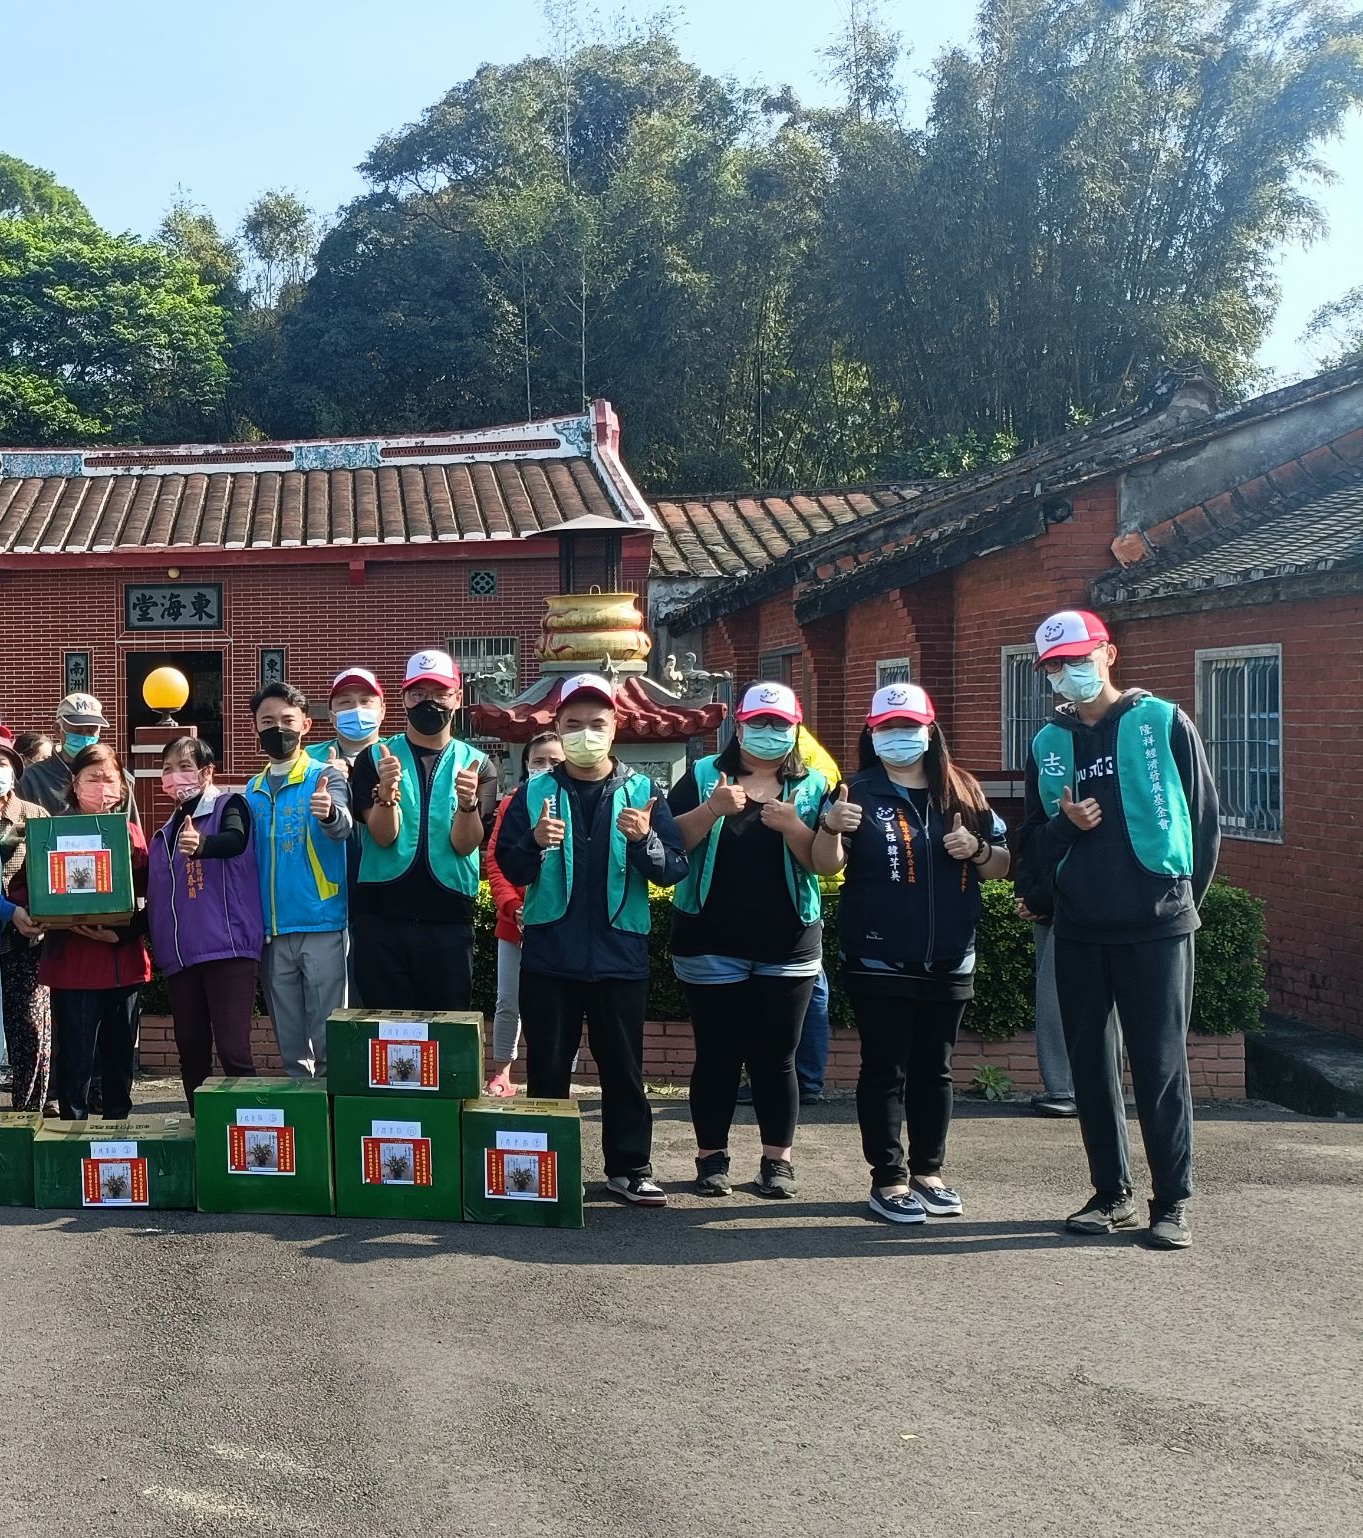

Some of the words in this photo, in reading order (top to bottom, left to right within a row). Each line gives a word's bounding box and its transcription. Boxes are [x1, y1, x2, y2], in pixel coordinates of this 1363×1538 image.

[132, 592, 215, 622] 東海堂
[1040, 752, 1065, 776] 志
[1139, 724, 1170, 830] 隆祥經濟發展基金會
[885, 822, 896, 842] 主任
